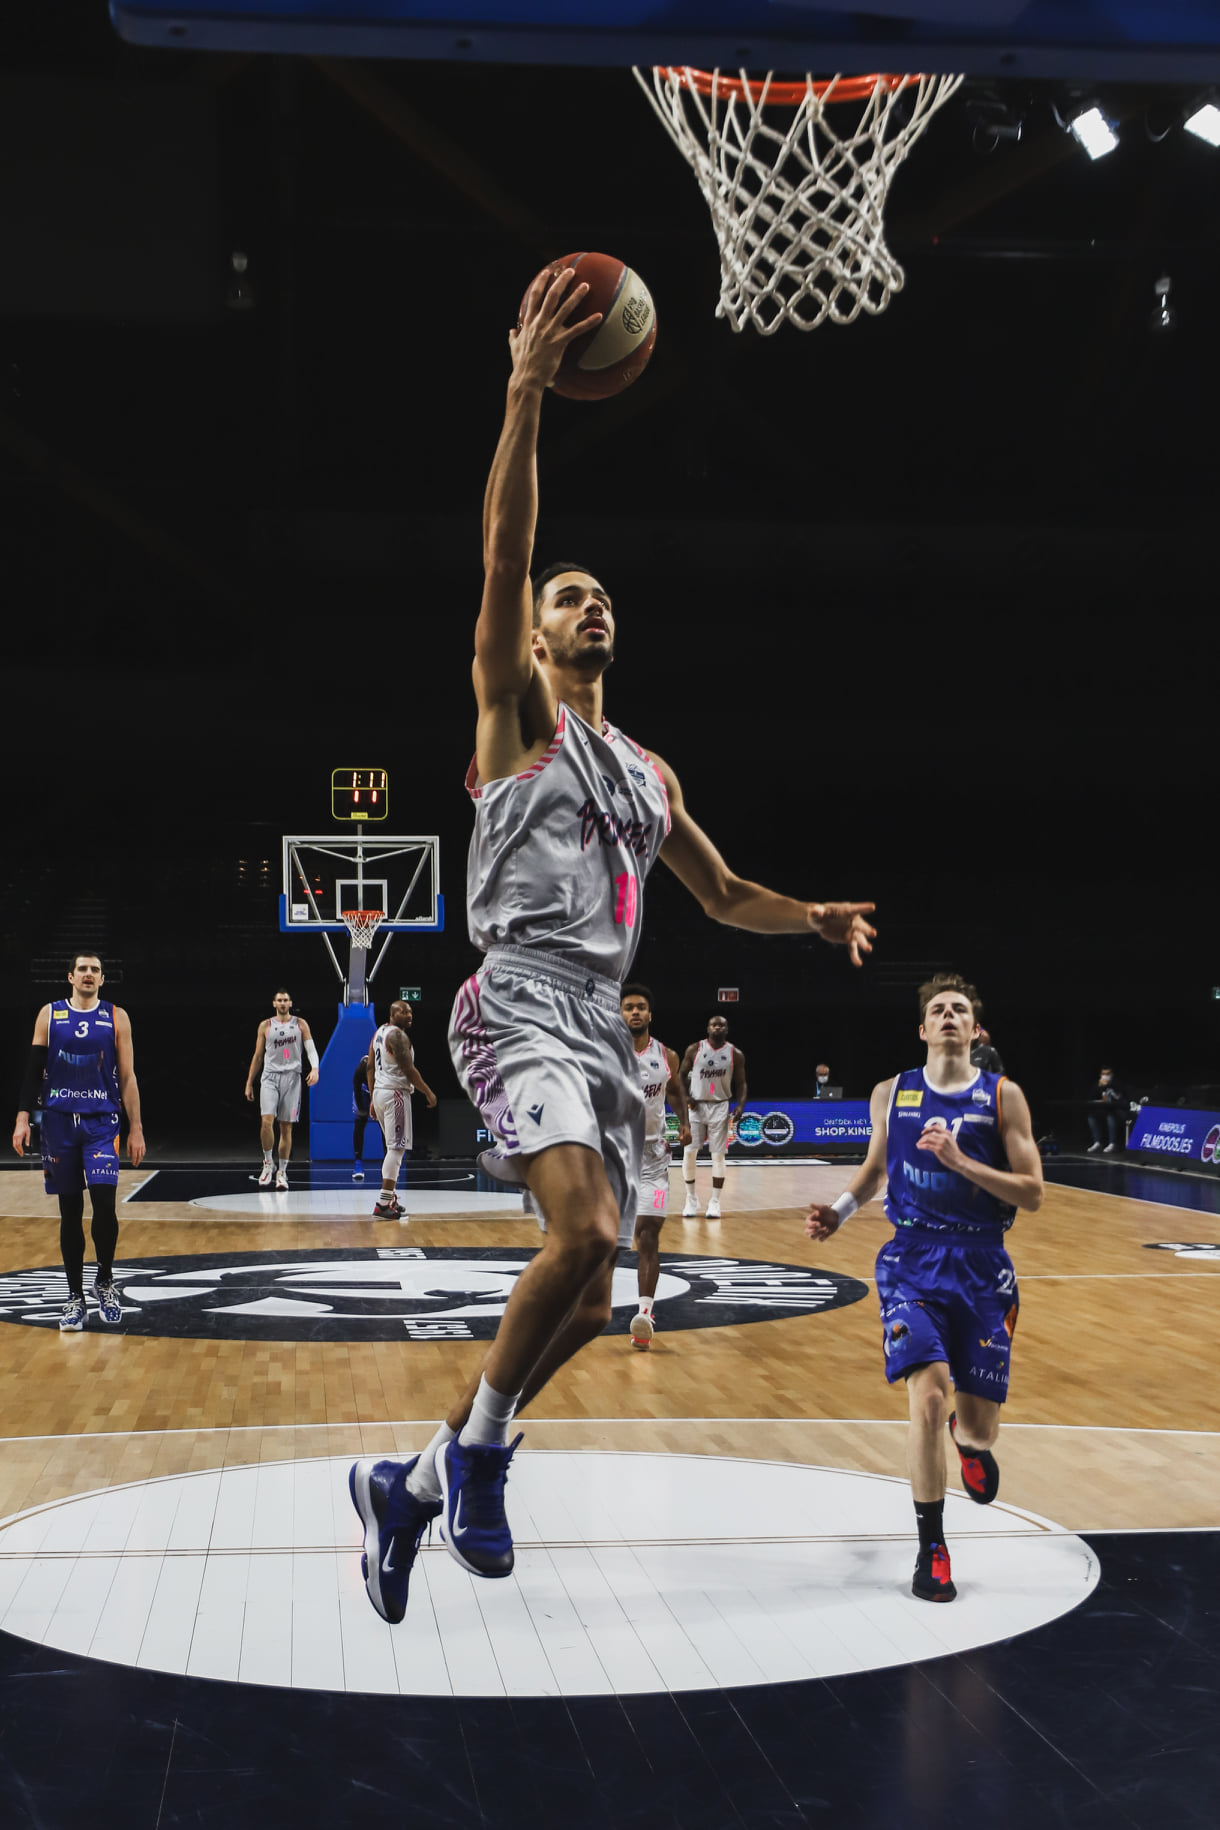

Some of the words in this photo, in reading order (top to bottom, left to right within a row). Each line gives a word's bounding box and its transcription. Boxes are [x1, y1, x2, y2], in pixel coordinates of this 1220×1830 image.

[353, 771, 386, 788] 1:11
[74, 1021, 89, 1038] 3
[815, 1126, 873, 1136] SHOP.KINE
[1140, 1133, 1193, 1154] FILMDOOSJES
[653, 1189, 666, 1209] 27
[659, 1259, 838, 1308] PHOENIX
